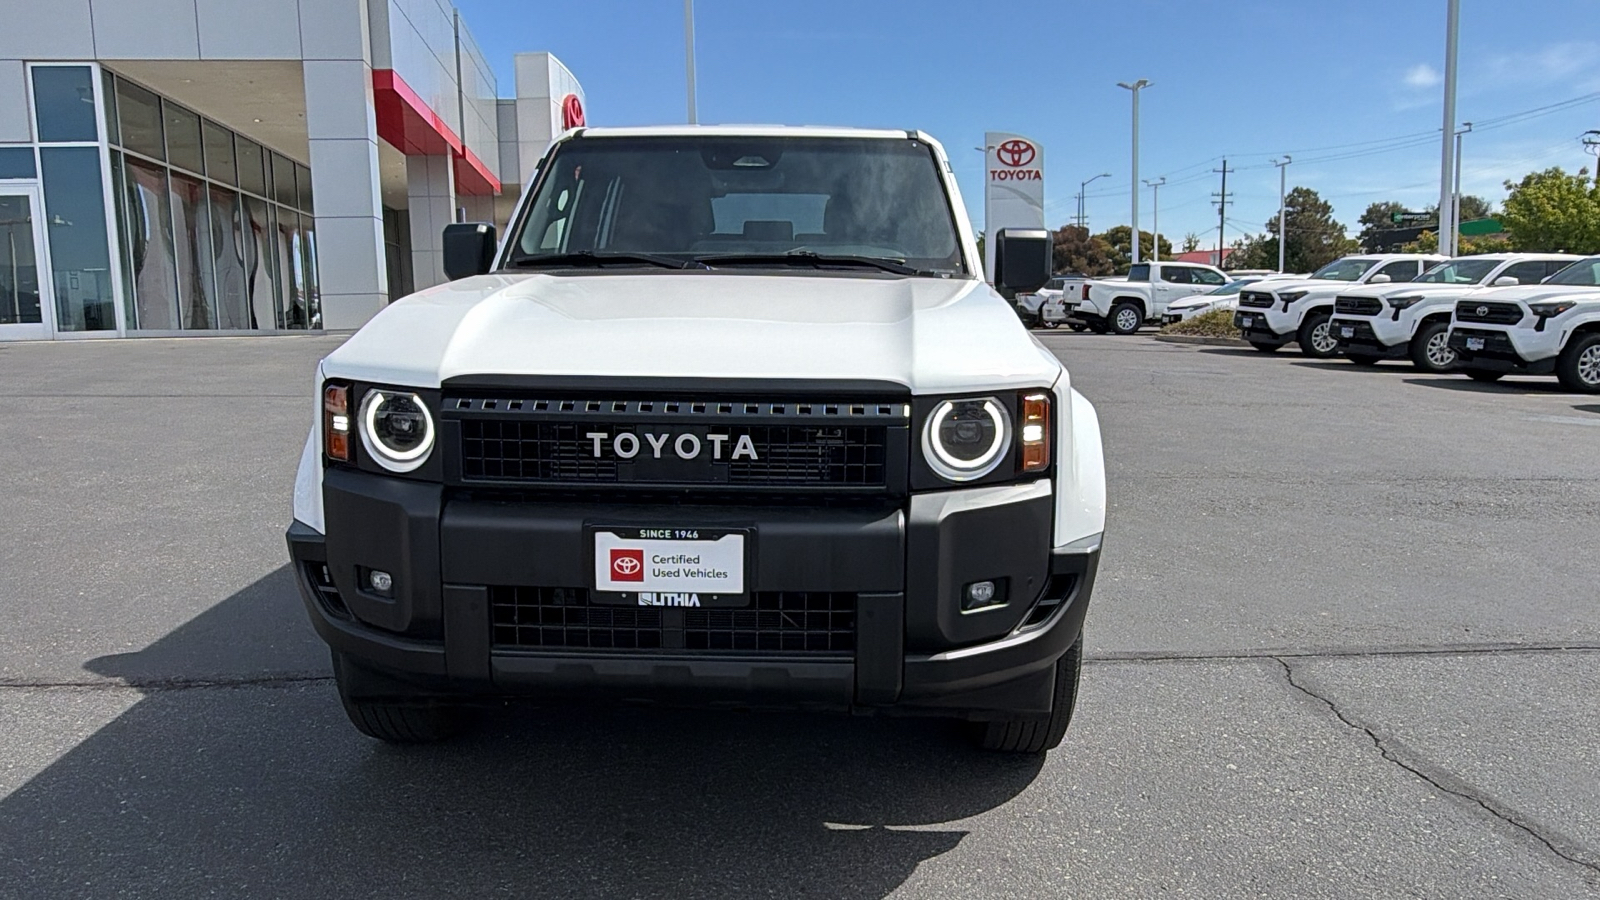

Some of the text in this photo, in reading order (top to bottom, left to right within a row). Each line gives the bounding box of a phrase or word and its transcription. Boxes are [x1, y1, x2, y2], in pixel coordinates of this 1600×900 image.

[990, 170, 1042, 181] TOYOTA
[586, 432, 759, 460] TOYOTA
[640, 529, 699, 539] SINCE 1946
[652, 554, 700, 564] Certified
[652, 568, 728, 579] Used Vehicles
[652, 592, 701, 607] LITHIA
